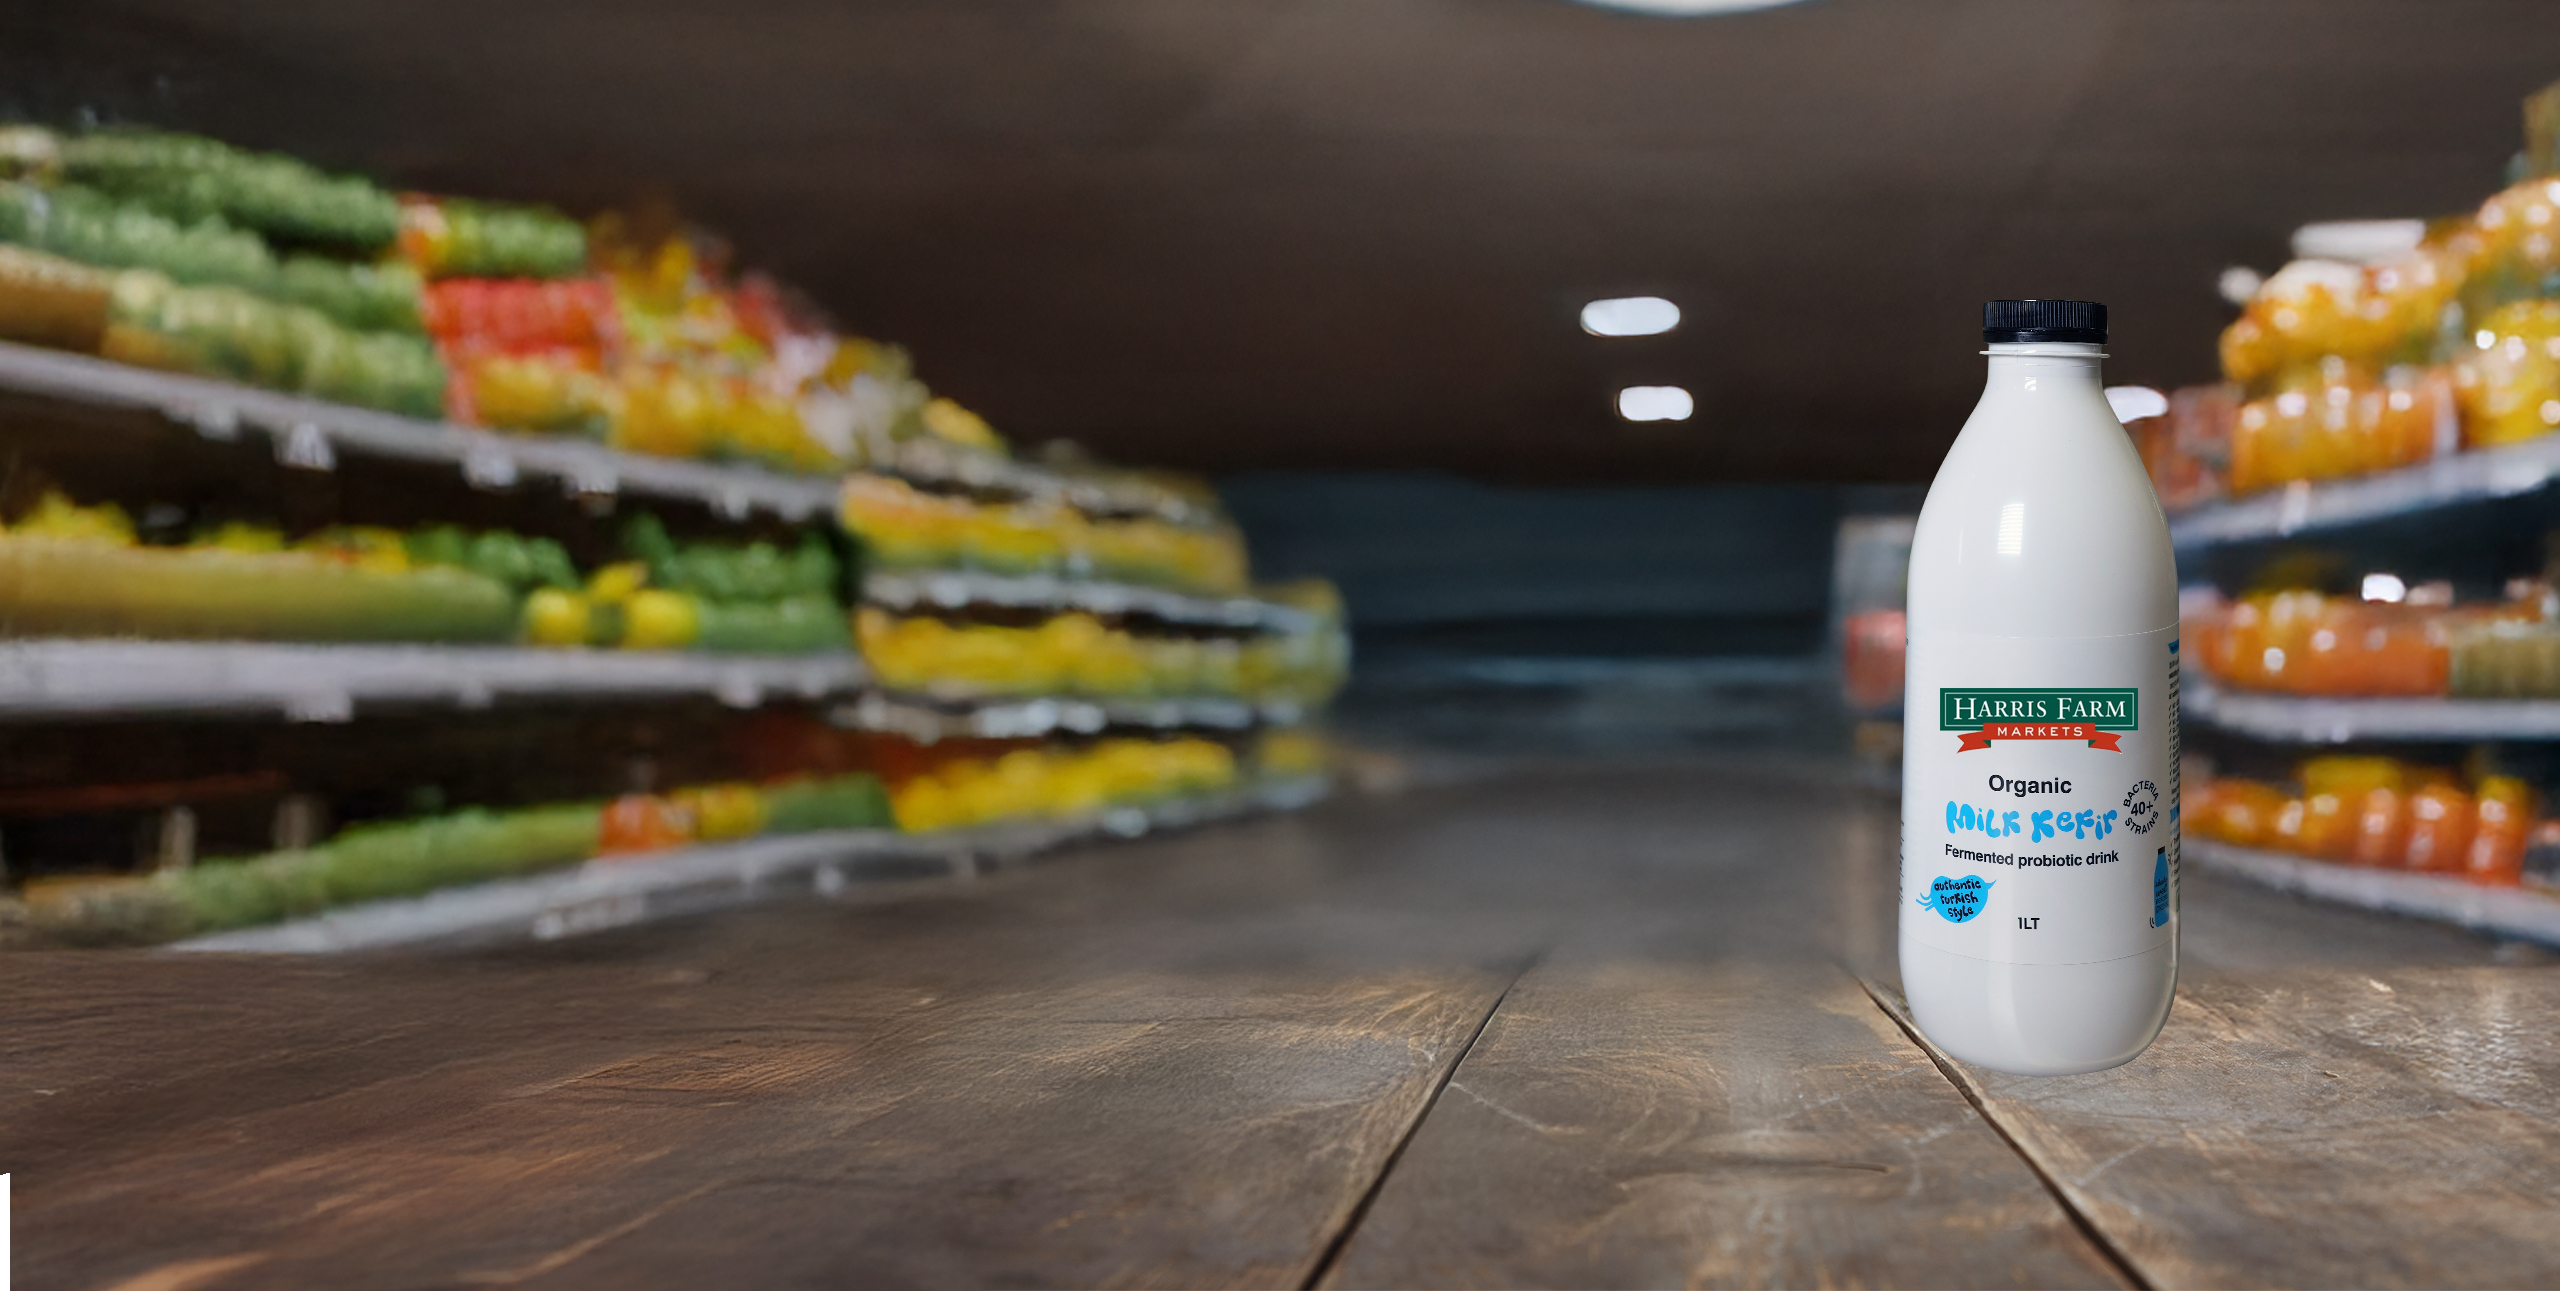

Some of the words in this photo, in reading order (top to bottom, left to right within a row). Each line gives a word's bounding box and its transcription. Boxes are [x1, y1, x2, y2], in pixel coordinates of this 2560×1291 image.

[1954, 697, 2047, 720] HARRIS
[2056, 697, 2126, 720] FARM
[1997, 726, 2083, 737] MARKETS
[1988, 774, 2072, 797] Organic
[2123, 780, 2159, 807] BACTERIA
[2131, 801, 2153, 816] 40+
[2125, 811, 2159, 834] STRAINS
[1945, 844, 2014, 866] Fermented
[2018, 853, 2083, 869] probiotic
[2086, 850, 2119, 865] drink
[1934, 879, 1982, 891] authentic
[2017, 917, 2040, 930] 1LT
